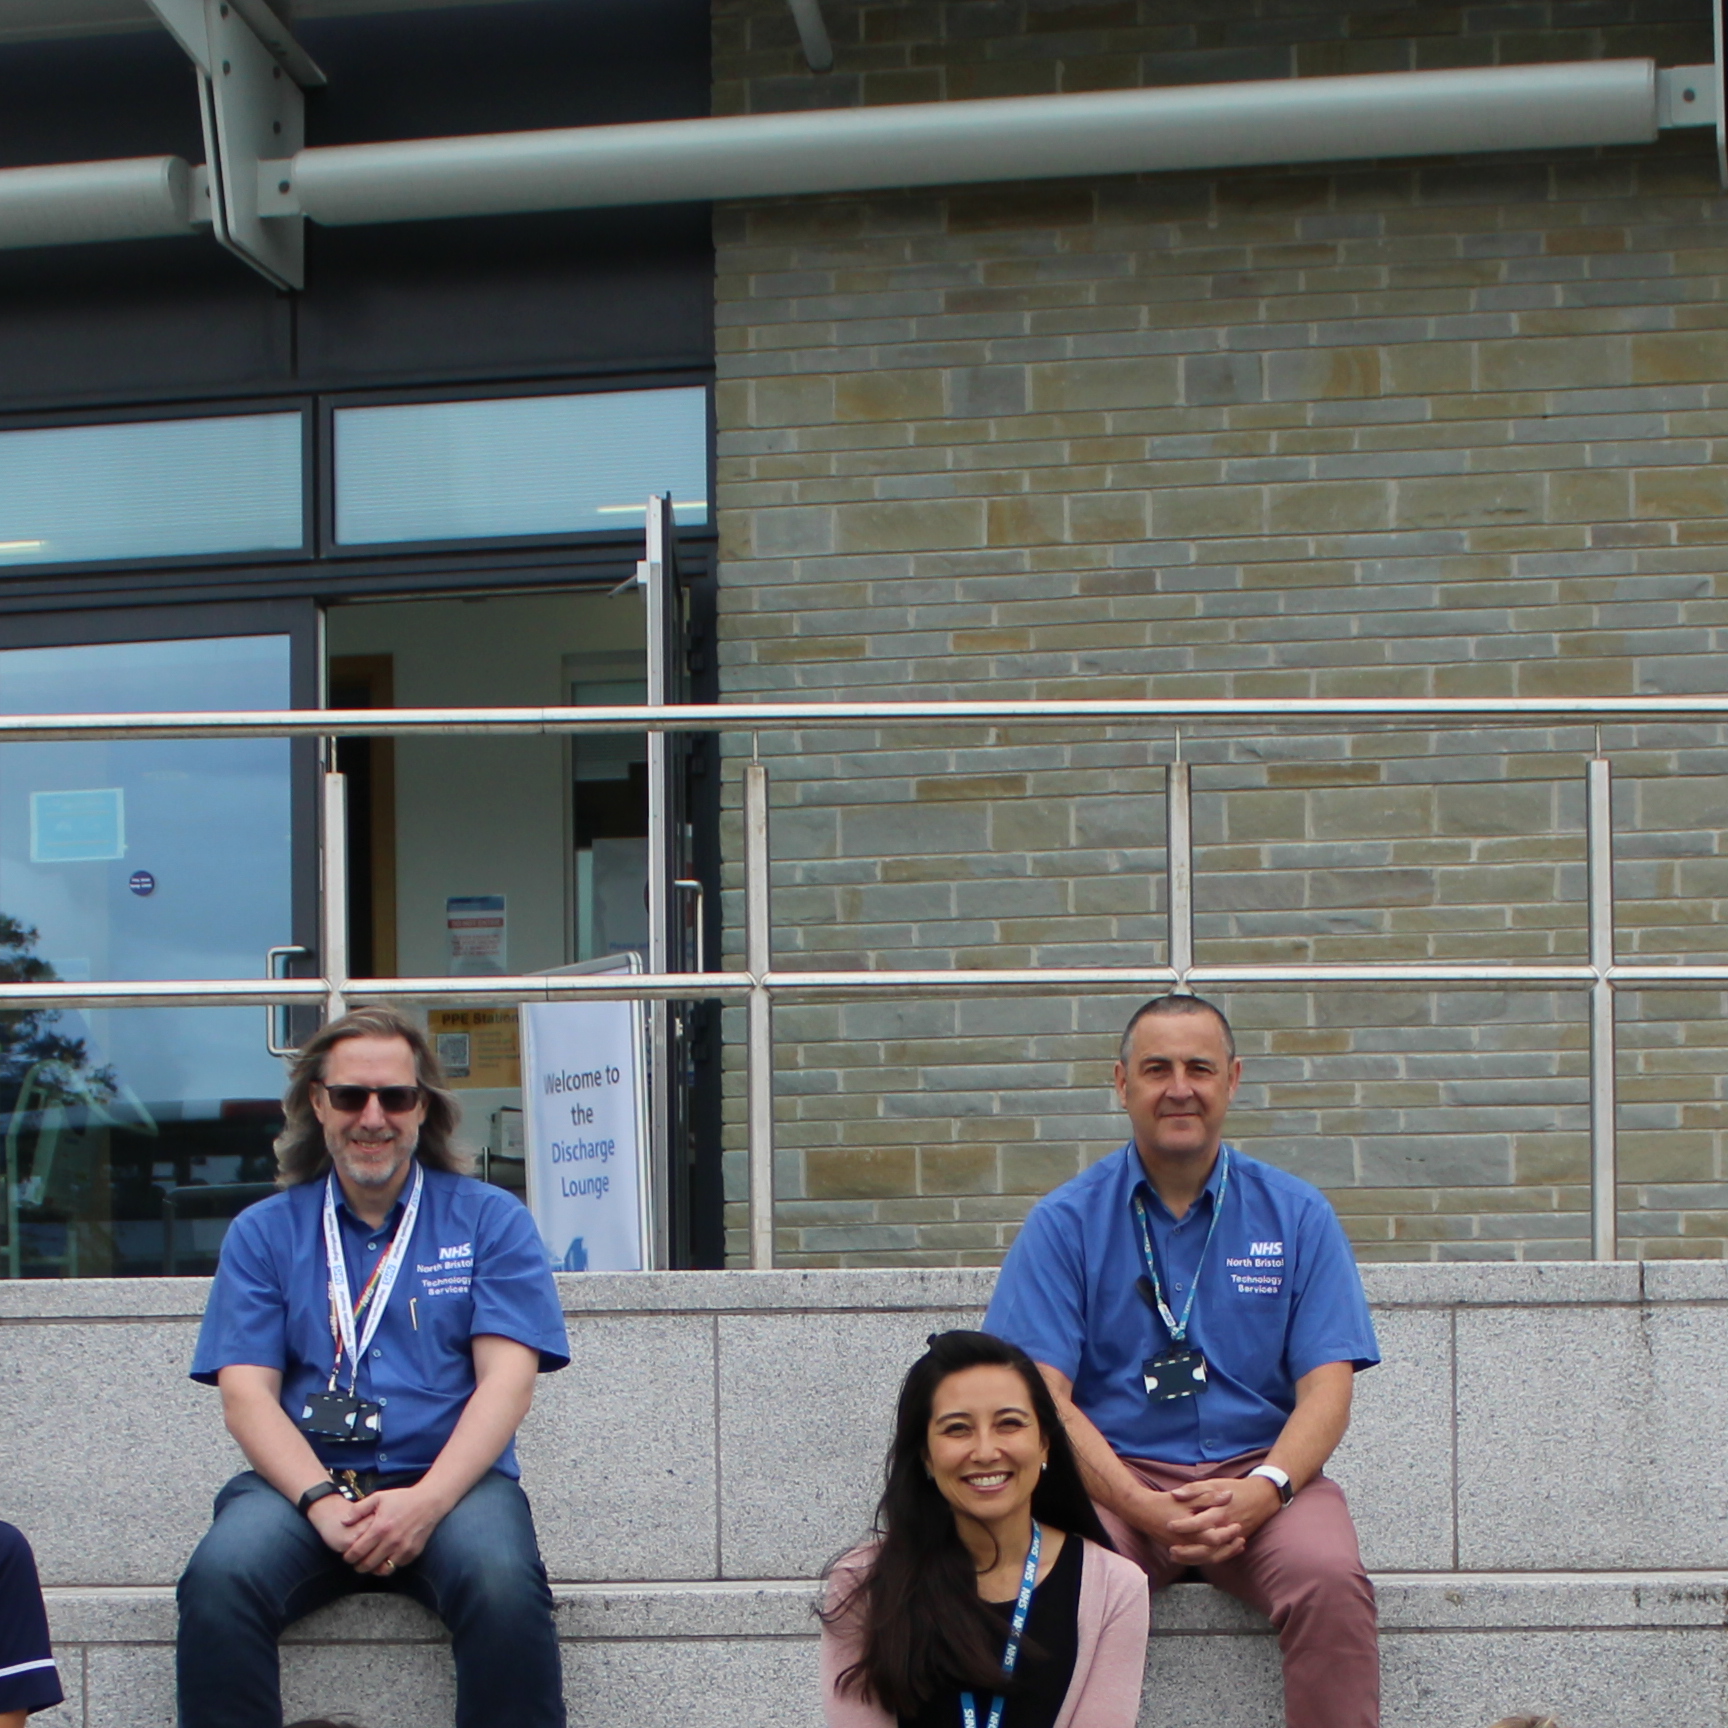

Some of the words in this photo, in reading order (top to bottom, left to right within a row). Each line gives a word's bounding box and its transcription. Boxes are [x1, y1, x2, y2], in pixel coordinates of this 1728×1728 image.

[442, 1013, 469, 1025] PPE
[544, 1069, 602, 1095] Welcome
[605, 1065, 620, 1085] to
[571, 1103, 593, 1126] the
[552, 1138, 615, 1164] Discharge
[561, 1176, 610, 1200] Lounge
[439, 1243, 471, 1260] NHS
[1250, 1242, 1283, 1256] NHS
[417, 1264, 442, 1273] North
[445, 1258, 473, 1269] Bristol
[1226, 1258, 1252, 1267] North
[1255, 1258, 1284, 1268] Bristol
[422, 1276, 471, 1287] Technology
[1231, 1274, 1282, 1285] Technology
[428, 1285, 469, 1296] Services
[1238, 1284, 1278, 1293] Services
[1024, 1560, 1036, 1582] NHS
[1018, 1586, 1031, 1610] NHS
[1004, 1644, 1017, 1666] NHS
